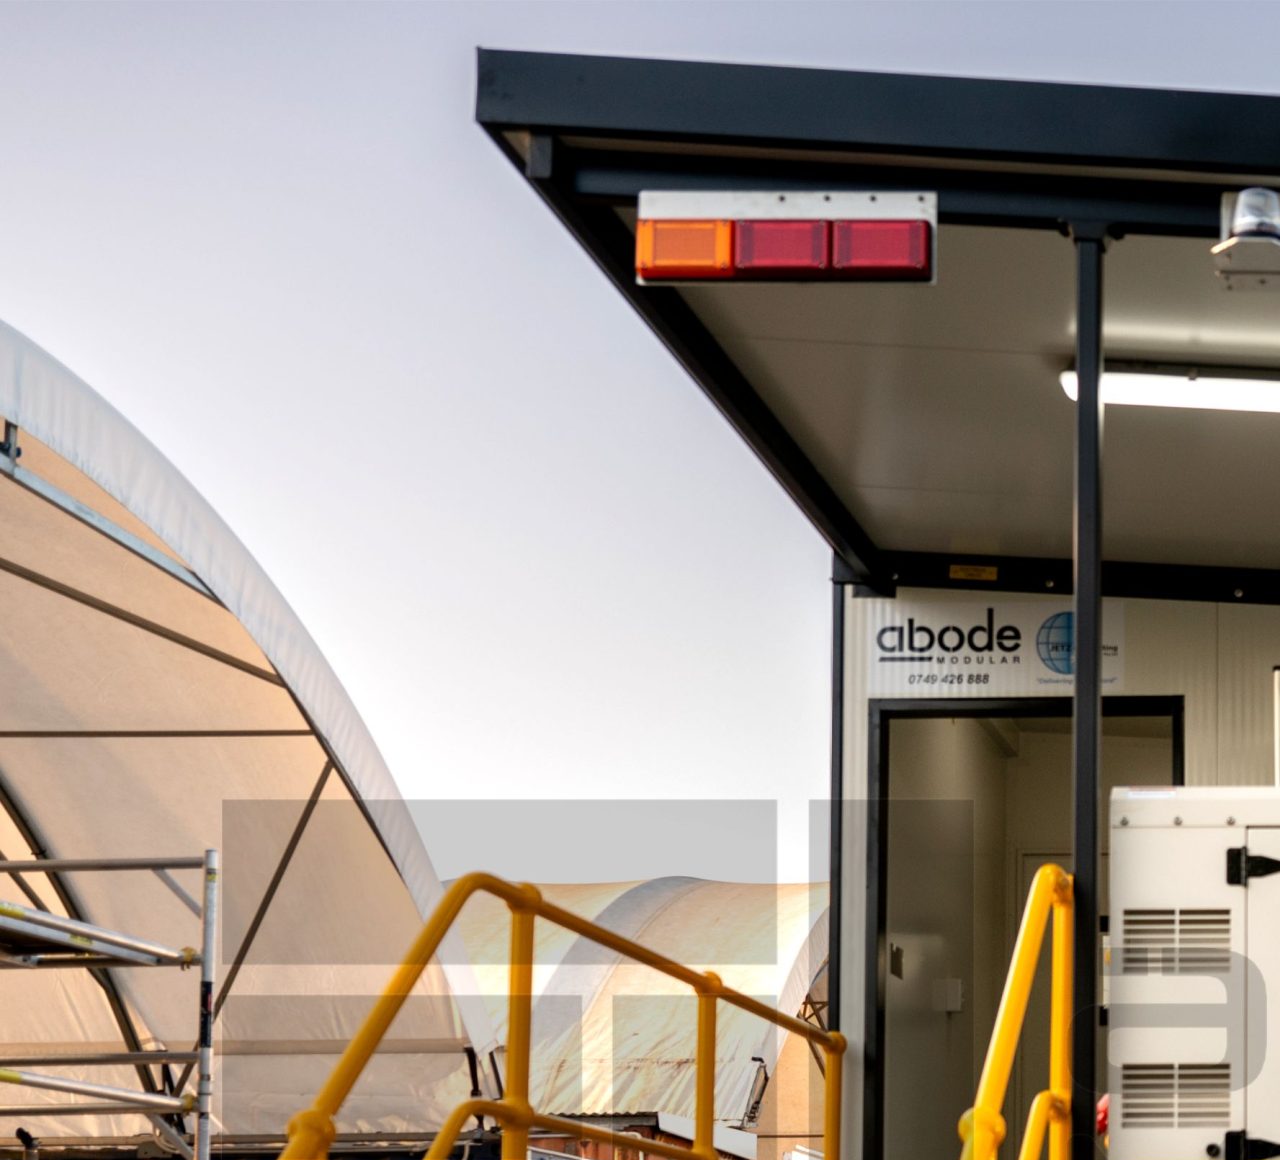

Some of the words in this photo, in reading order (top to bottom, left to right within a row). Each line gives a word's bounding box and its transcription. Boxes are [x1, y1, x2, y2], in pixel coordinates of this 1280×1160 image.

[876, 608, 1021, 652] abode
[908, 674, 937, 684] 0749
[941, 674, 963, 684] 426
[966, 674, 989, 684] 888
